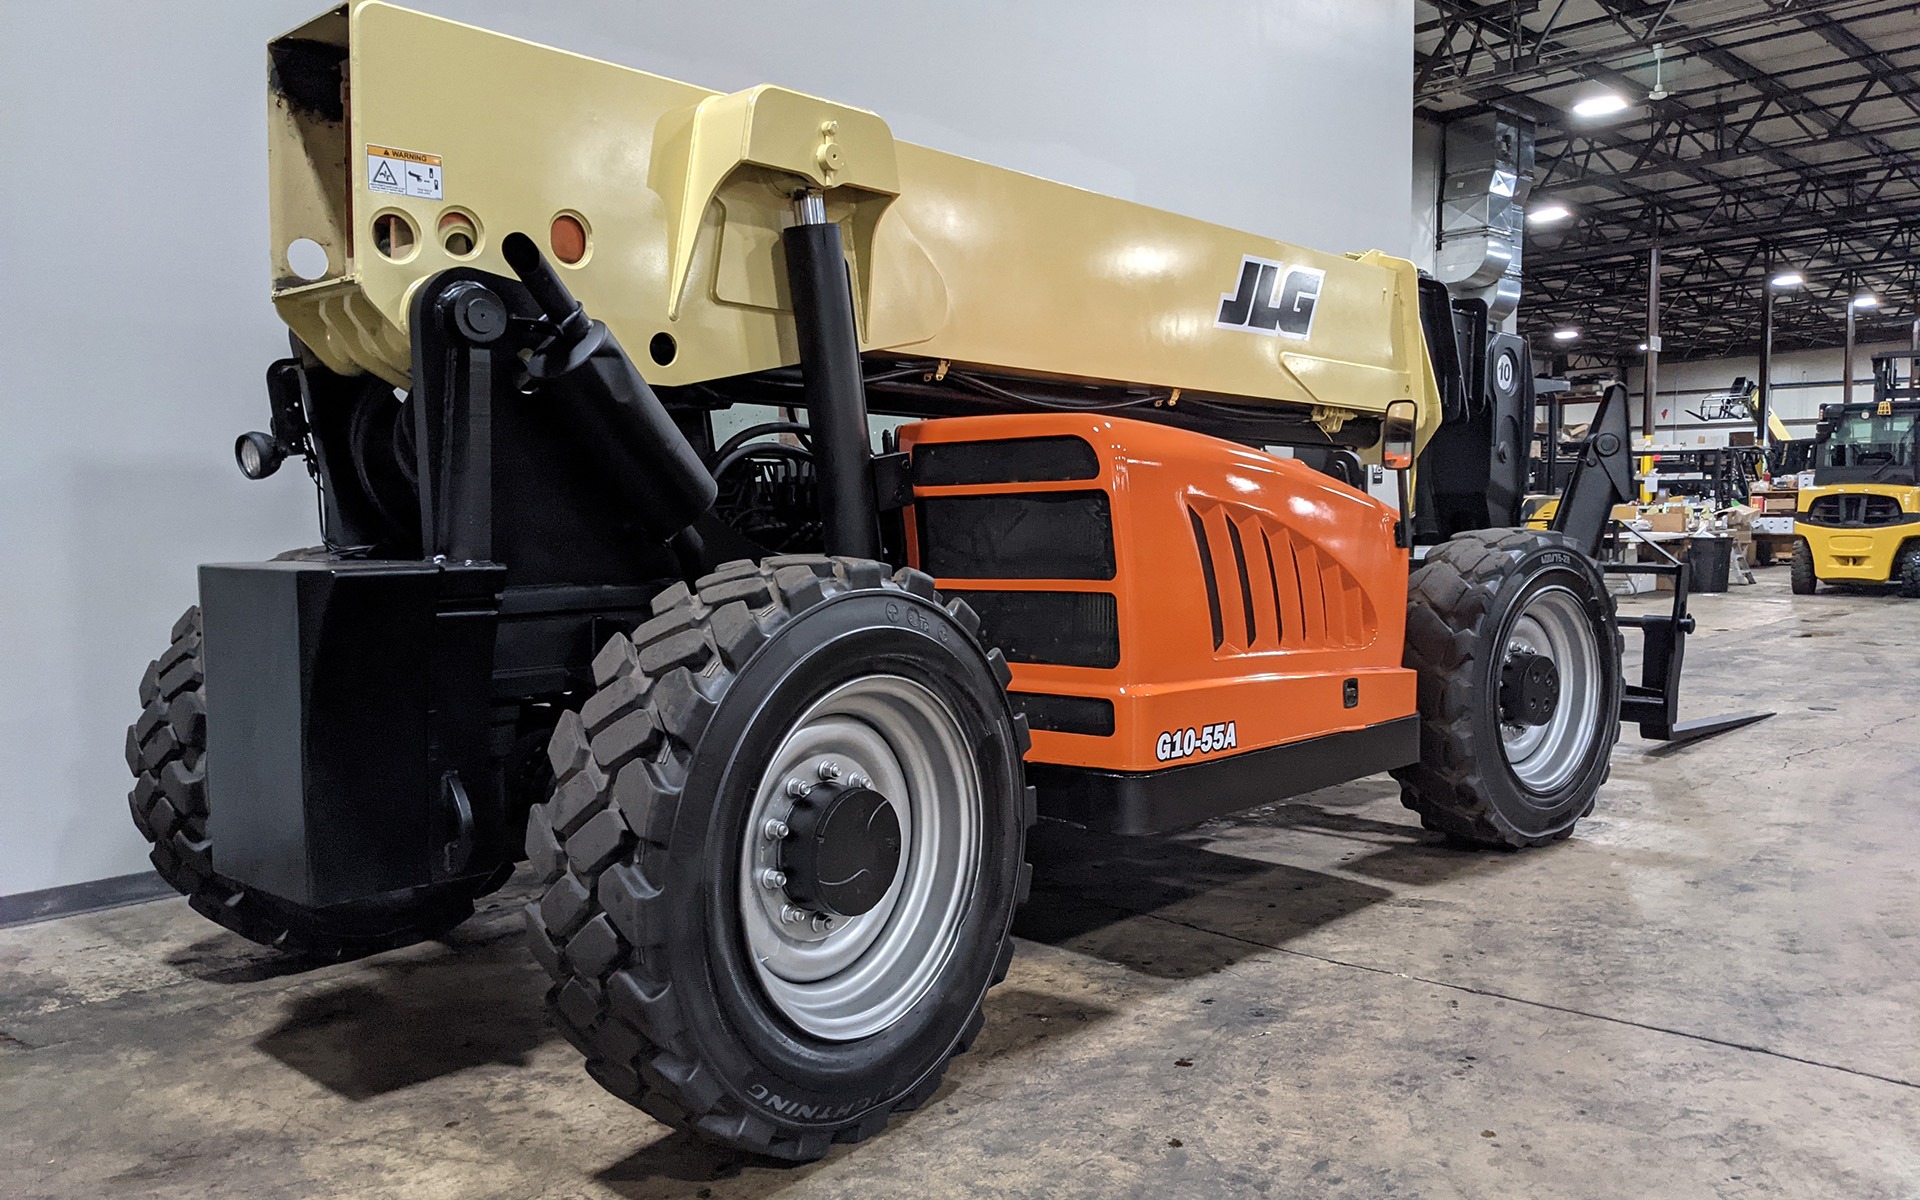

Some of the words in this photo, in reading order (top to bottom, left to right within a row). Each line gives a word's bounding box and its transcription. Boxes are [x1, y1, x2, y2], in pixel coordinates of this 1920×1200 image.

[391, 150, 427, 162] WARNING
[1215, 257, 1324, 338] JLG
[1499, 362, 1510, 381] 10
[1156, 720, 1237, 762] G10-55A
